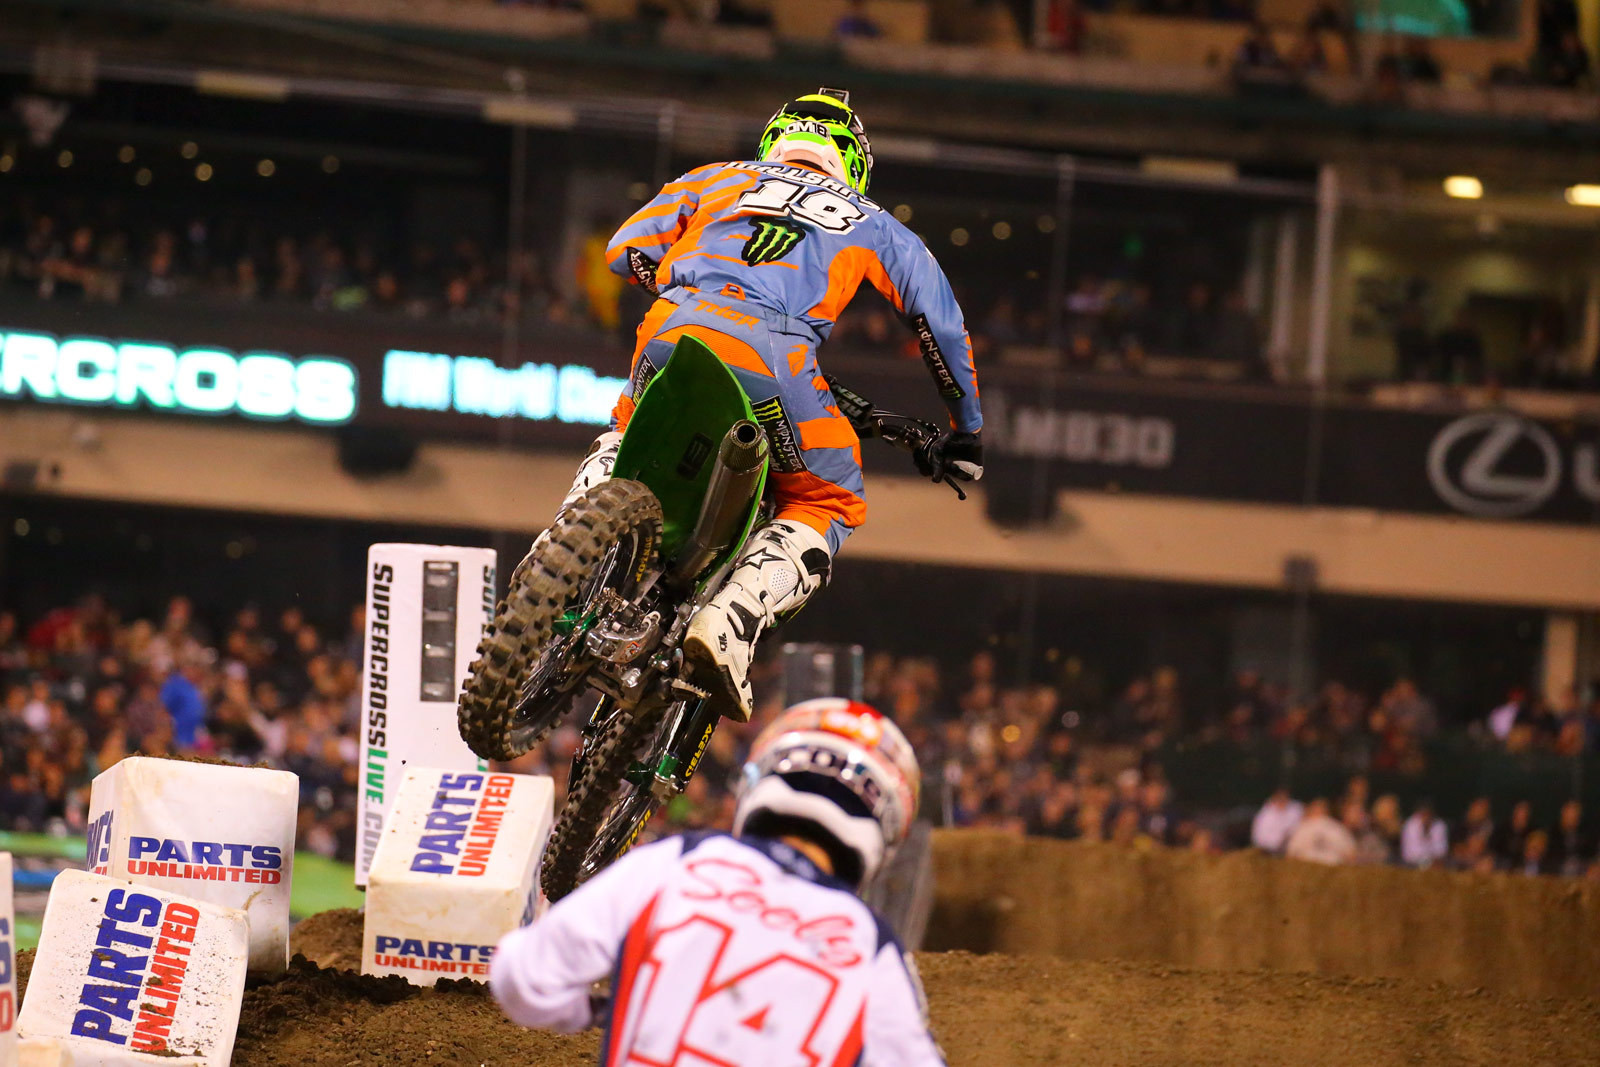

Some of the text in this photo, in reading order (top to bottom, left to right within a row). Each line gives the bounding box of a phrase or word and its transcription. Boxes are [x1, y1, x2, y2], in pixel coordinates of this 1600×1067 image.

[733, 178, 869, 235] 18
[0, 332, 356, 422] RCROSS
[916, 317, 954, 387] MONSTER
[776, 419, 803, 471] MONSTER
[685, 723, 713, 778] ACERBIS
[129, 836, 282, 869] PARTS
[409, 773, 484, 875] PARTS
[457, 775, 515, 877] UNLIMITED
[127, 860, 281, 884] UNLIMITED
[71, 888, 163, 1045] PARTS
[130, 902, 200, 1050] UNLIMITED
[374, 954, 492, 975] UNLIMITE
[375, 935, 498, 962] PARTS
[627, 912, 840, 1067] 14
